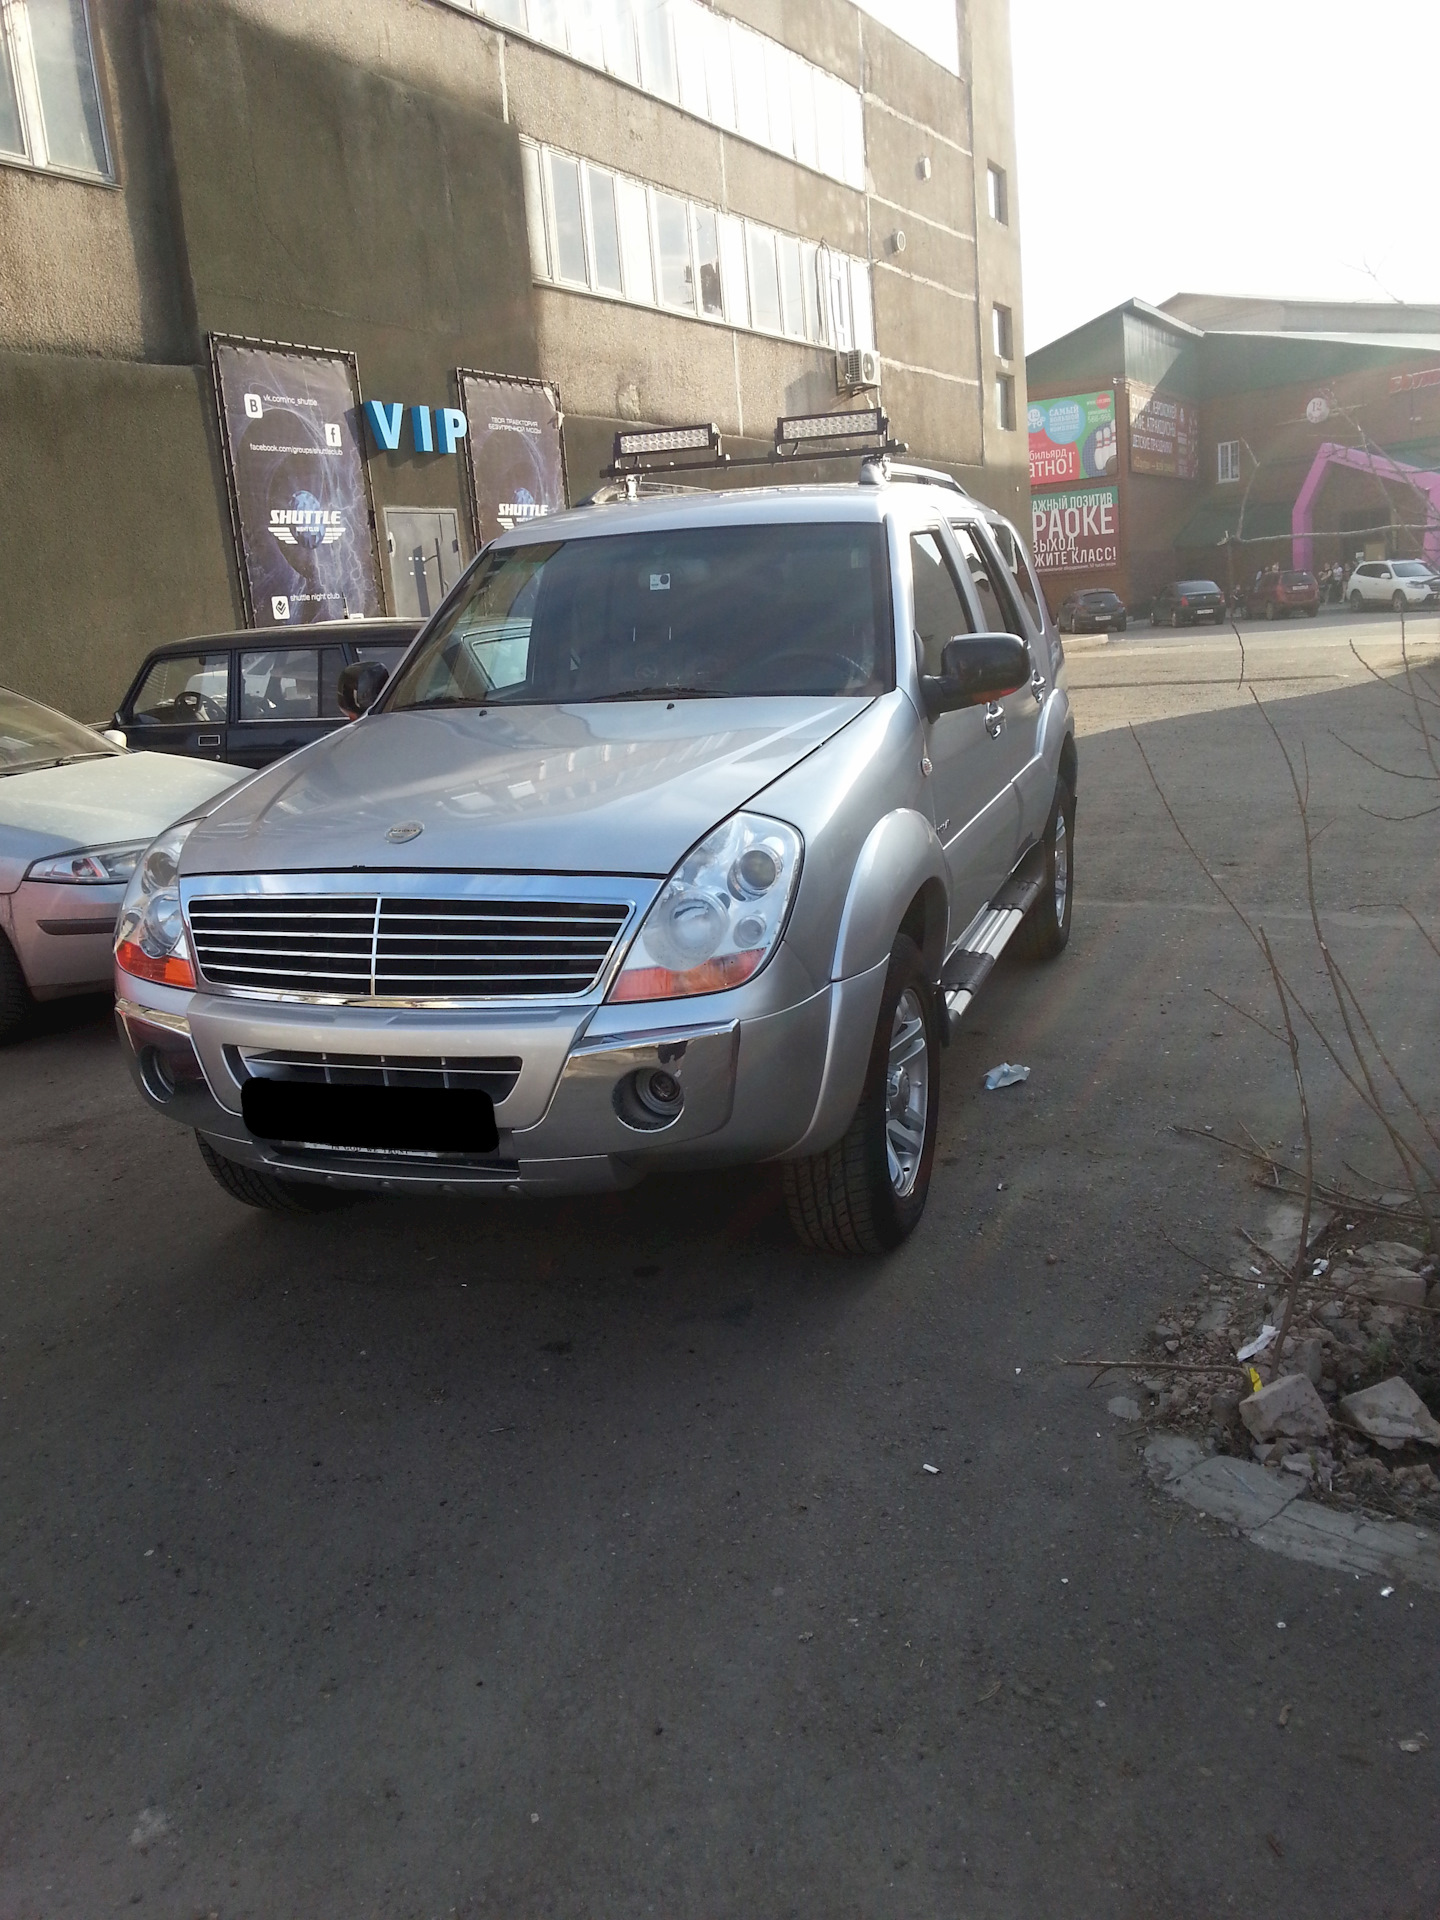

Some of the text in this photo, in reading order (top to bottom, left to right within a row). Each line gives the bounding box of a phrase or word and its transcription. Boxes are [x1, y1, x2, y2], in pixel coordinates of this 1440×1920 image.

[1049, 404, 1079, 417] САМЫЙ
[363, 400, 468, 454] VIP
[1030, 448, 1067, 461] бильярд
[498, 503, 549, 516] SHUTTLE
[1032, 492, 1113, 512] АЖНЫЙ ПОЗИТИВ
[270, 509, 342, 525] SHUTTLE
[1032, 502, 1115, 541] РАОКЕ
[1034, 546, 1117, 567] ЖИТЕ КЛАСС!
[290, 593, 310, 601] shuttle
[311, 594, 326, 602] night
